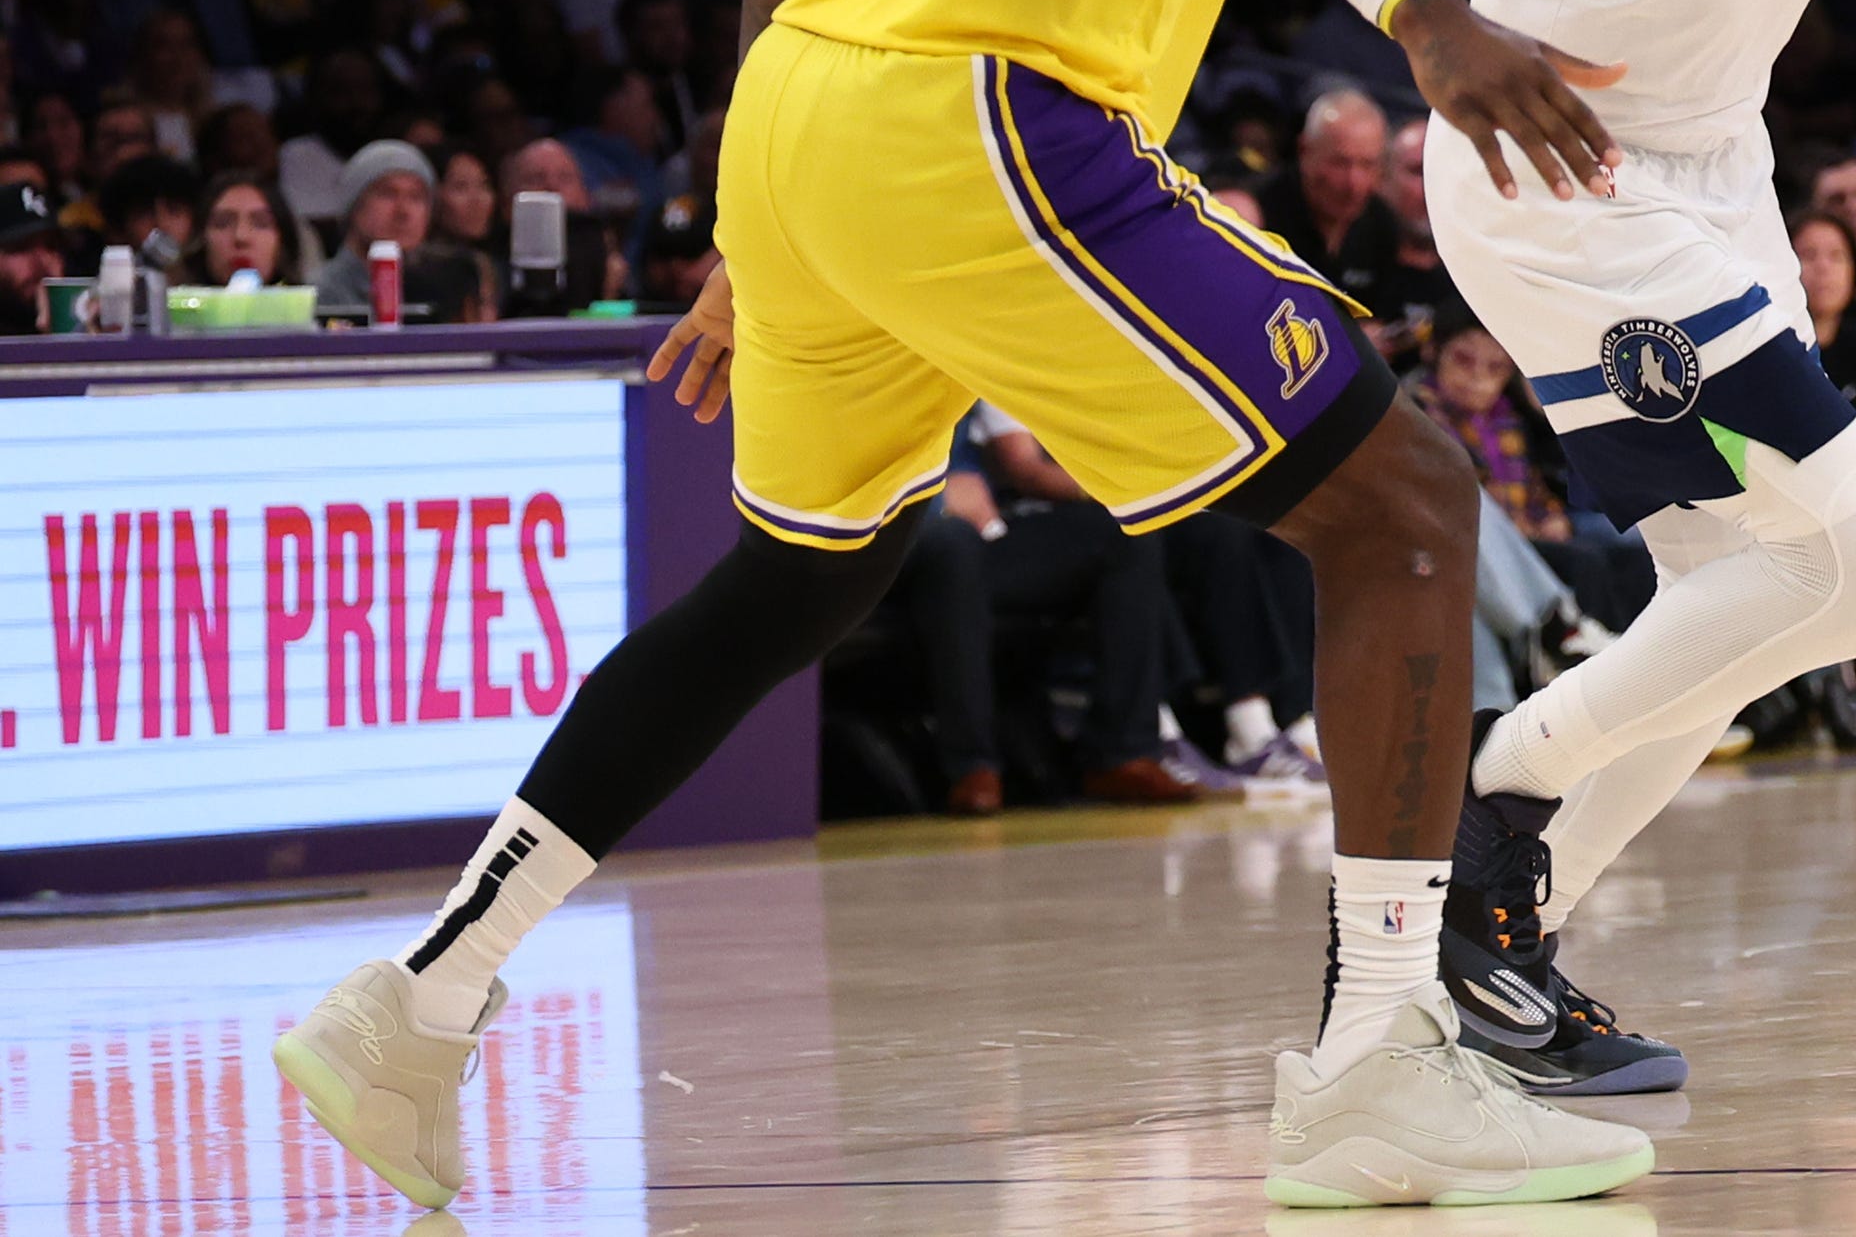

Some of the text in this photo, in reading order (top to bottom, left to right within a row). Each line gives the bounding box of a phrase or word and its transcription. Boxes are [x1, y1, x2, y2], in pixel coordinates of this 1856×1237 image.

[1602, 322, 1697, 398] MINNESOTA TIMBERWOLVES
[44, 492, 590, 743] WIN PRIZES
